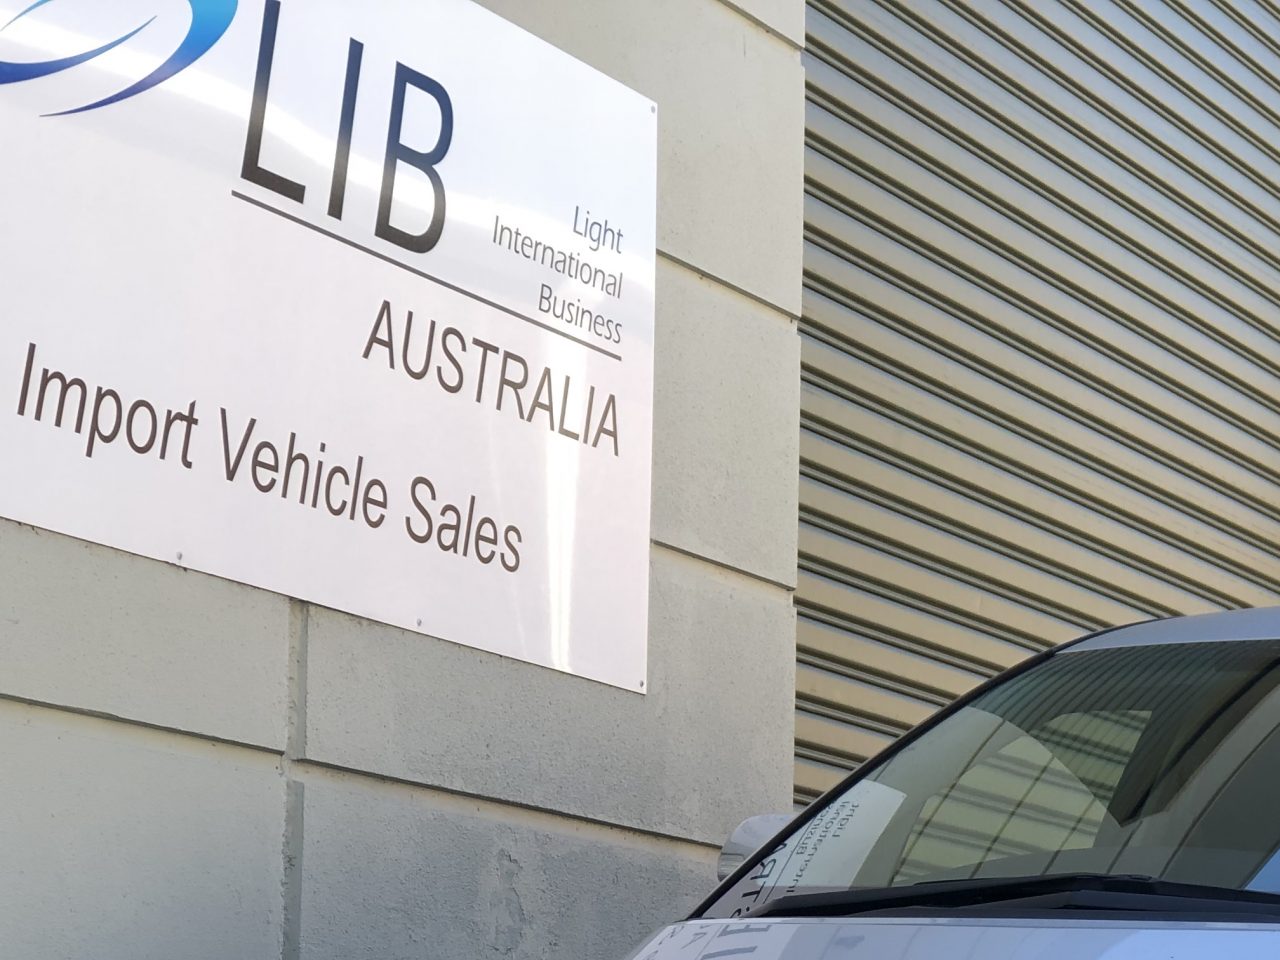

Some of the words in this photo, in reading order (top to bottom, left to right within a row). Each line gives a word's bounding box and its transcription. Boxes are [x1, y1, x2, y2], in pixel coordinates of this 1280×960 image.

[240, 0, 454, 254] LIB
[492, 215, 623, 299] International
[572, 205, 624, 255] Light
[538, 283, 623, 345] Business
[362, 300, 619, 457] AUSTRALIA
[17, 342, 199, 470] Import
[219, 406, 388, 530] Vehicle
[405, 476, 523, 573] Sales
